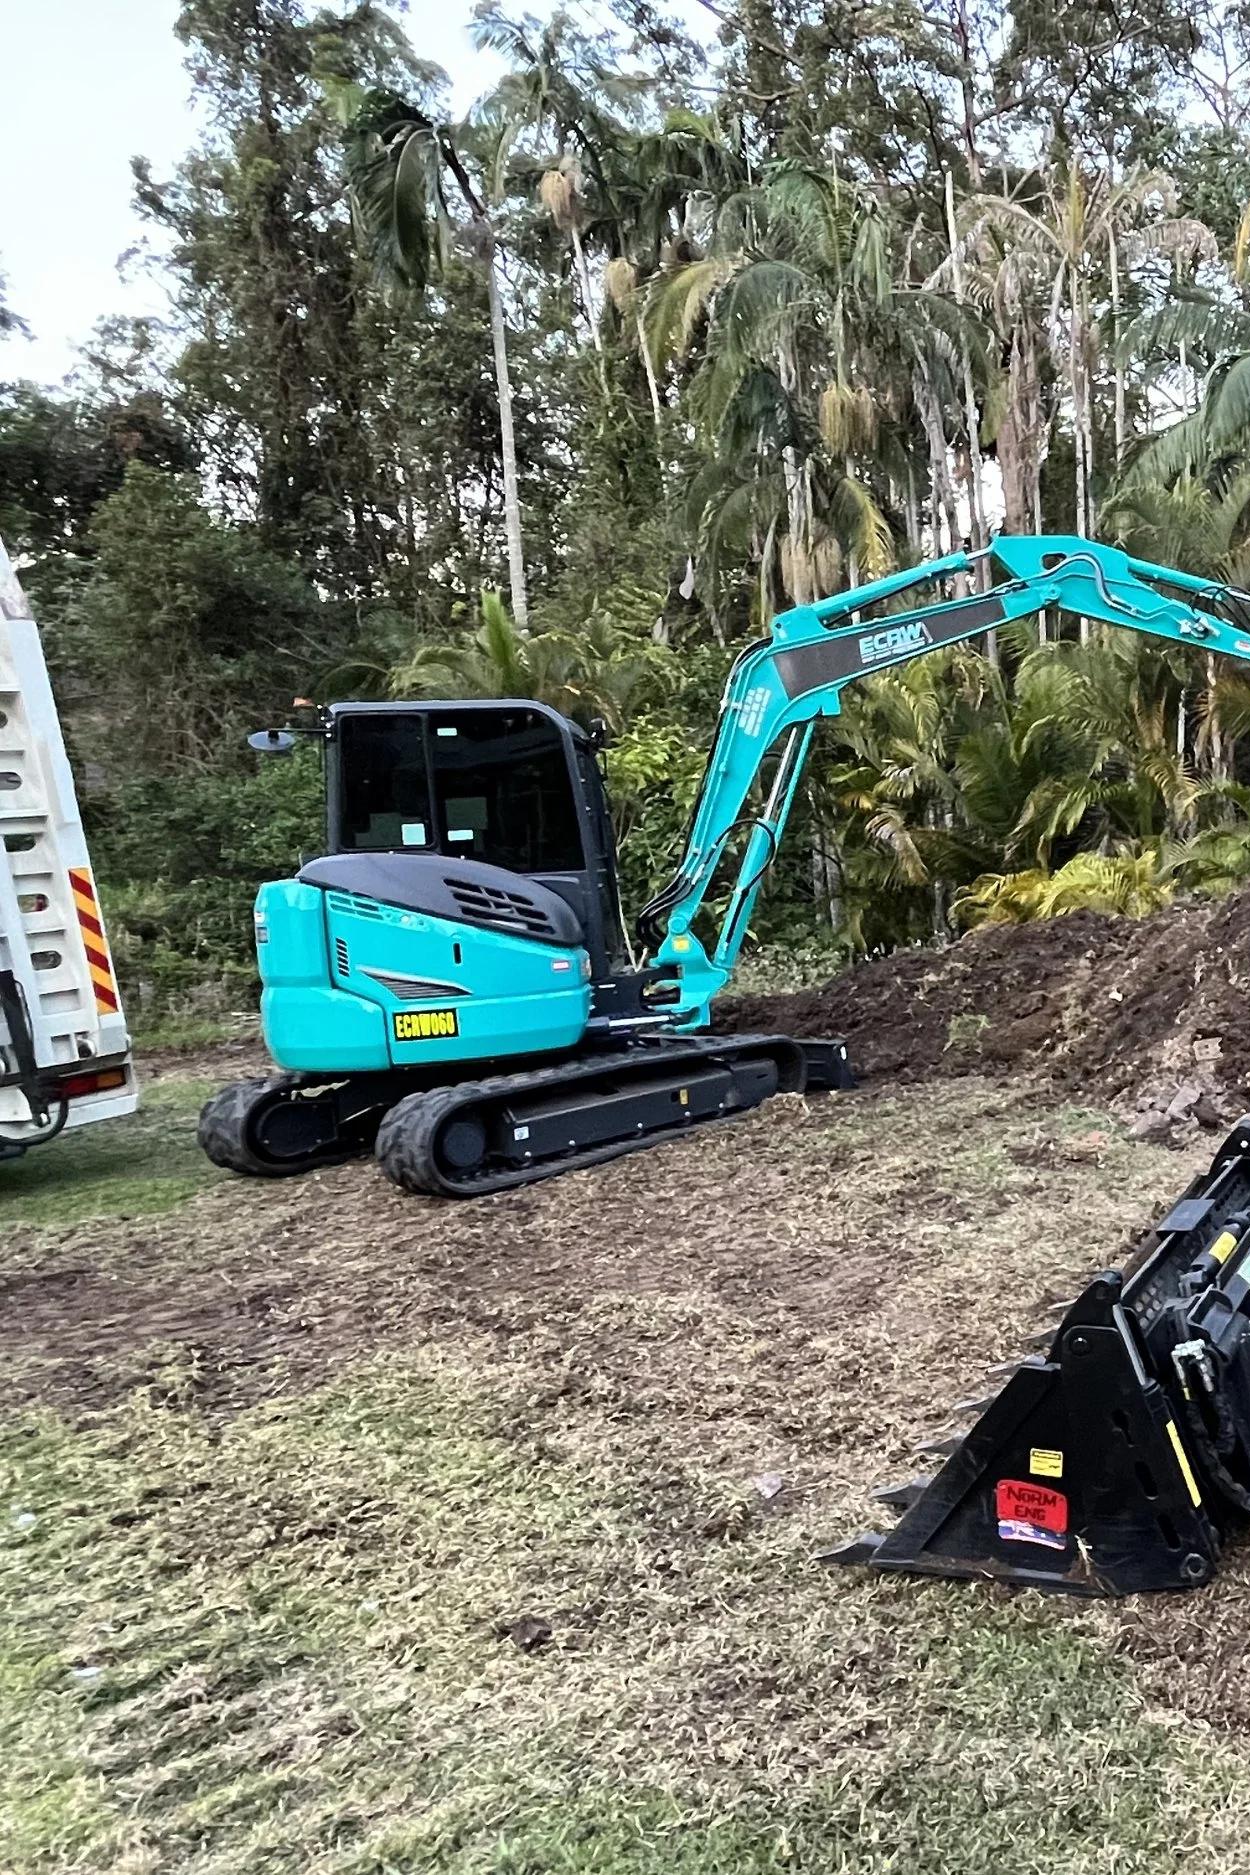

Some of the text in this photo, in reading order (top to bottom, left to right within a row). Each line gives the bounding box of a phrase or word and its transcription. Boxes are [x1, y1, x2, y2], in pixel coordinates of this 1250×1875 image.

[859, 621, 921, 655] ECRW
[395, 1012, 455, 1038] ECRW060
[1014, 1504, 1047, 1521] ENG
